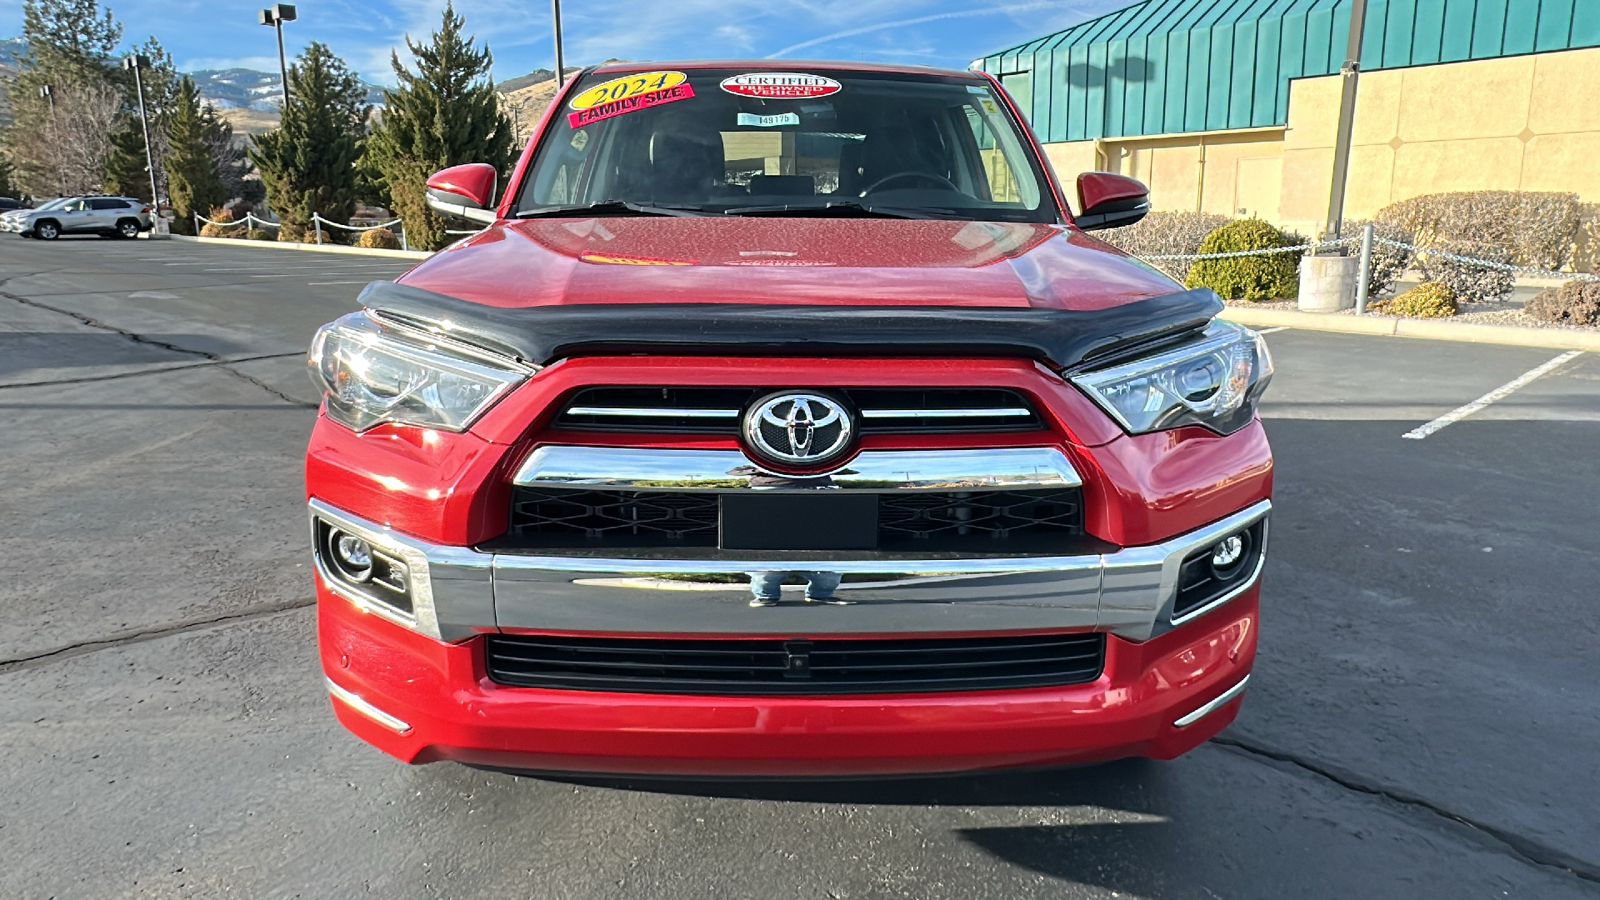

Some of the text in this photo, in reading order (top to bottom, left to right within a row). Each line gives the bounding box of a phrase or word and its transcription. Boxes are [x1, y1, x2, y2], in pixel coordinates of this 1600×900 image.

[592, 73, 668, 107] 2024
[735, 77, 828, 86] CERTIFIED
[578, 86, 684, 122] FAMILY SIZE
